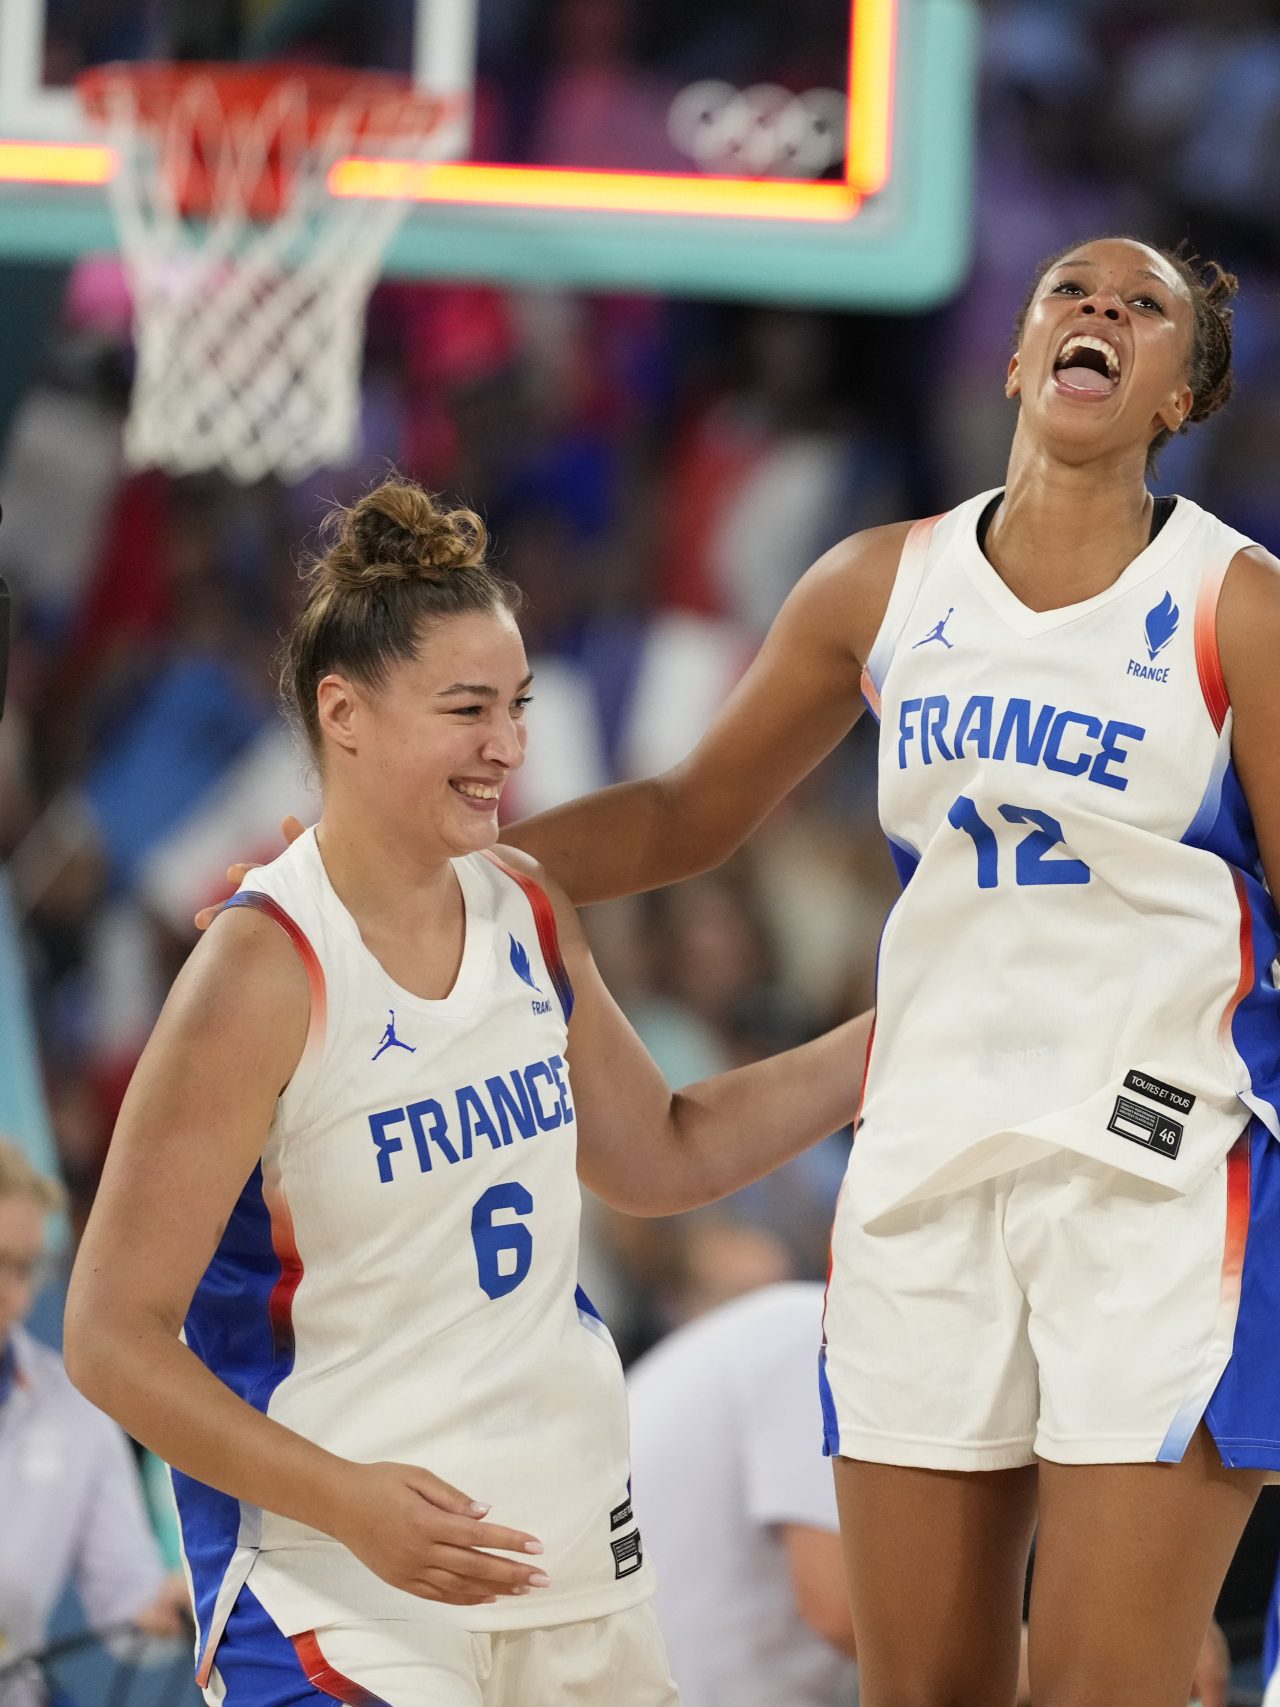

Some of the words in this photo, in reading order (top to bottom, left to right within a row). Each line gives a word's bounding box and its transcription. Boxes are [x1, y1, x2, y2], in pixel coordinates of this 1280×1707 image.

[1127, 659, 1170, 683] FRANCE
[898, 695, 1146, 792] FRANCE
[947, 795, 1091, 889] 12
[532, 998, 552, 1016] FRAN
[368, 1054, 574, 1183] FRANCE
[1131, 1075, 1160, 1095] TOUTES
[1159, 1089, 1169, 1099] ET
[1170, 1093, 1191, 1108] TOUS
[1159, 1128, 1176, 1145] 46
[471, 1181, 534, 1301] 6
